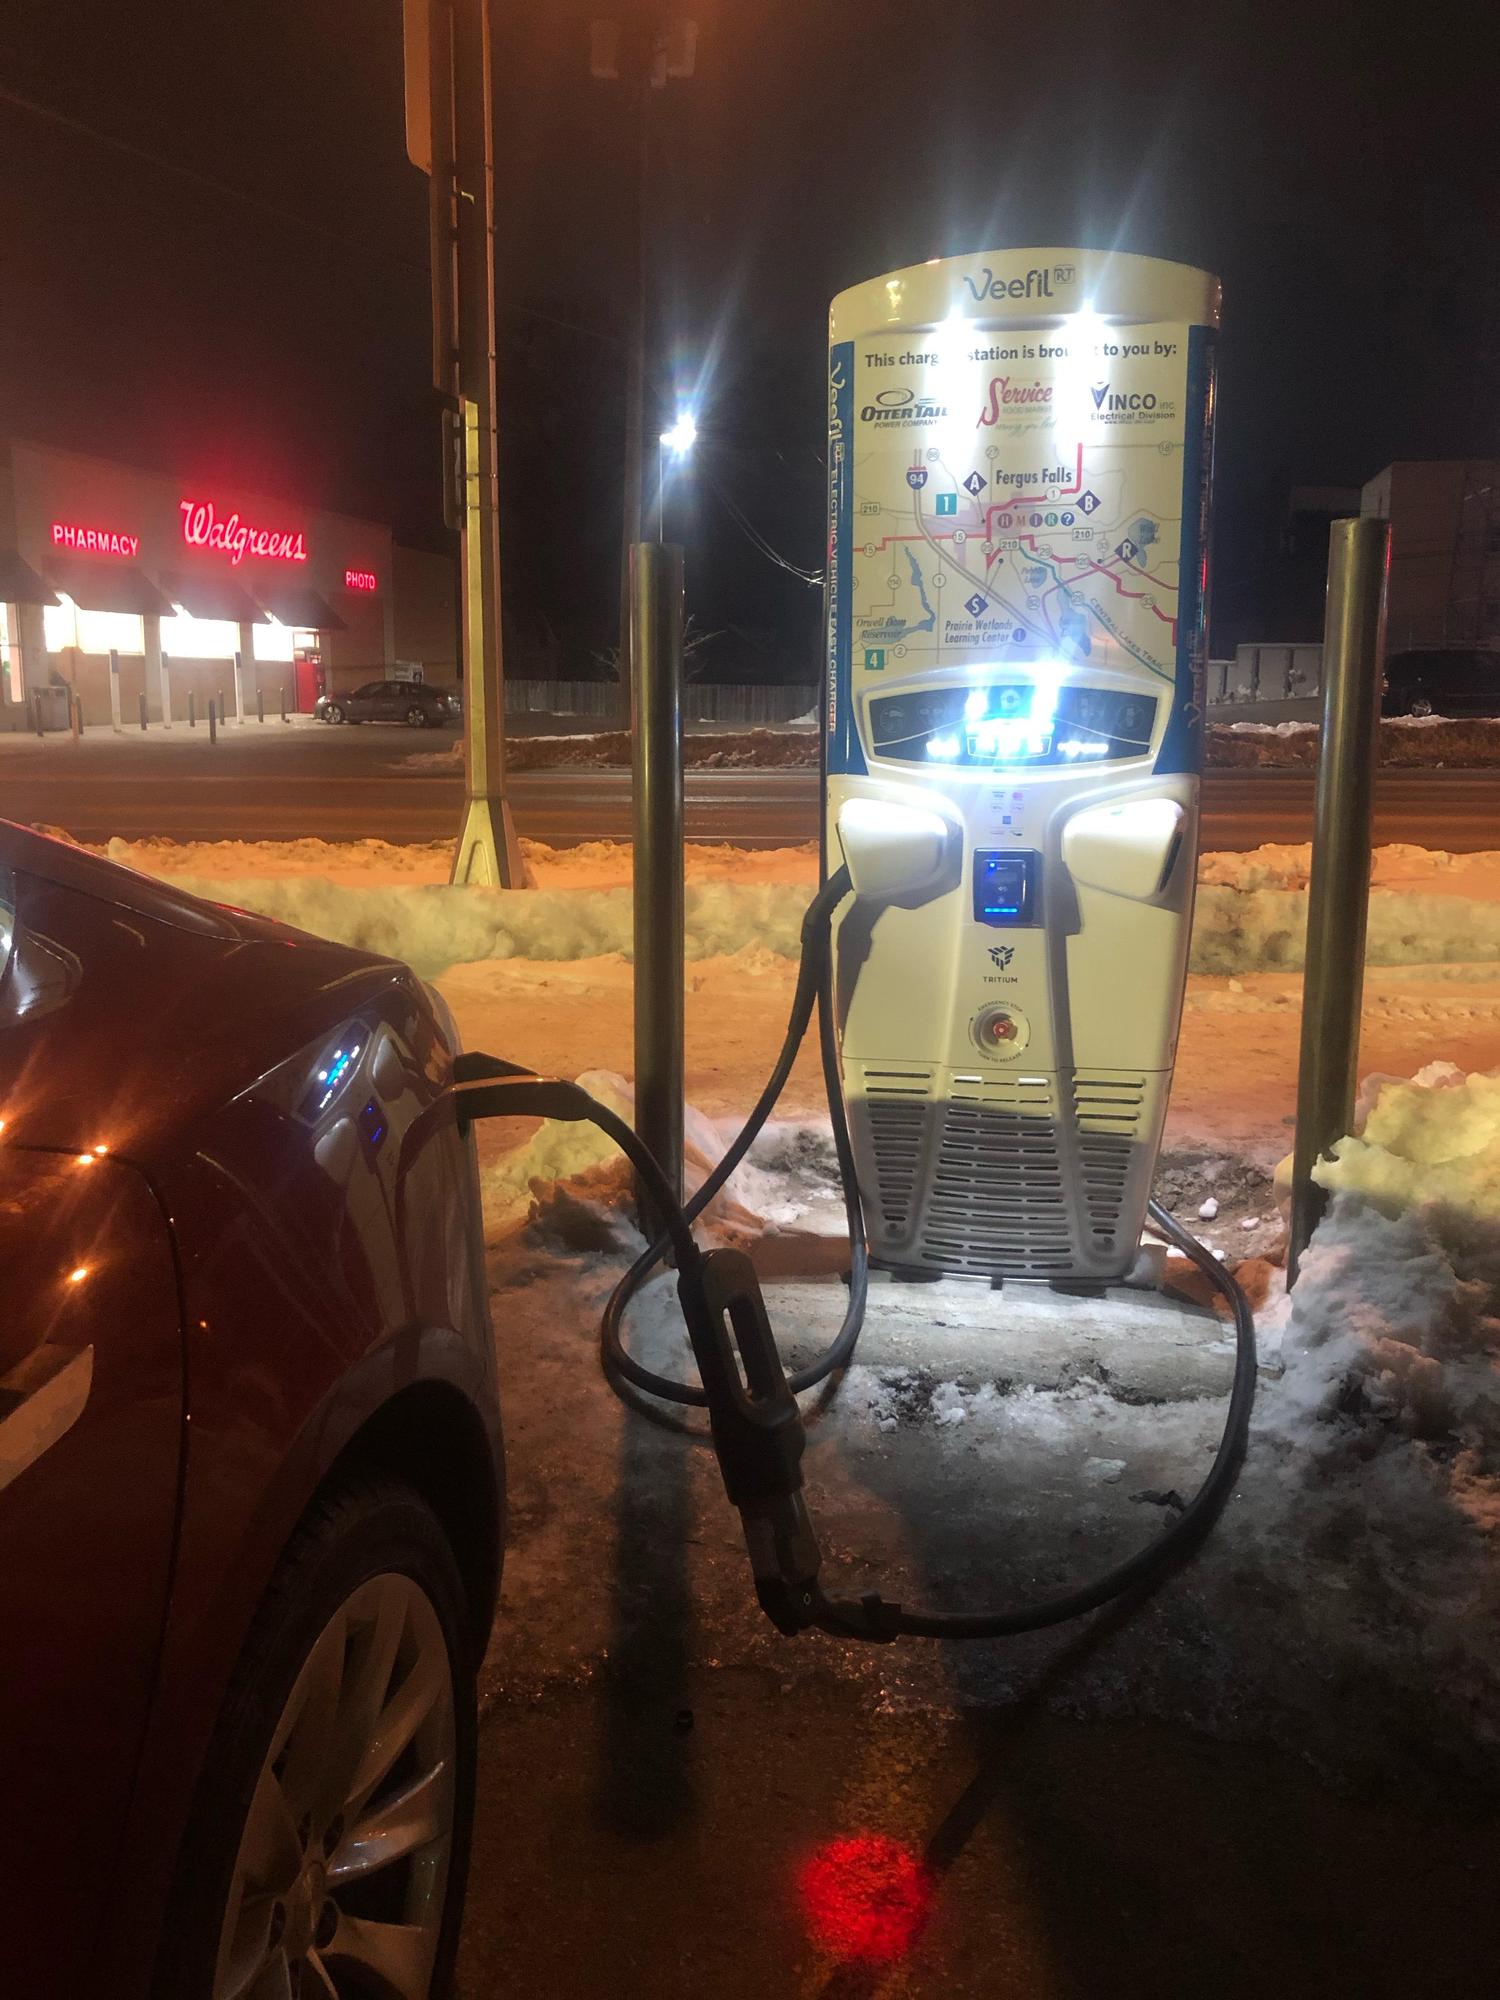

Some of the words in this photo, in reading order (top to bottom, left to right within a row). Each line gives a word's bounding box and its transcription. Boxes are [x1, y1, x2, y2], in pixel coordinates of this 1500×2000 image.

[963, 267, 1054, 302] Veefil
[1055, 267, 1076, 282] RT
[865, 353, 895, 368] This
[899, 351, 944, 367] charg
[1022, 345, 1035, 359] is
[1103, 343, 1119, 356] to
[1122, 344, 1149, 359] you
[1154, 341, 1177, 359] by:
[976, 376, 1053, 429] Service
[1090, 382, 1157, 411] VINCO
[861, 406, 914, 421] OTTER
[1090, 412, 1135, 421] Electrical
[1138, 411, 1176, 420] Division
[874, 420, 901, 429] POWER
[909, 474, 924, 485] 94
[969, 474, 980, 490] A
[996, 469, 1038, 488] Fergus
[1042, 467, 1072, 483] Falls
[830, 468, 838, 545] ELECTRIC
[862, 504, 878, 513] 210
[1084, 495, 1093, 512] B
[52, 524, 140, 557] PHARMACY
[180, 500, 308, 565] Walgreens
[1074, 530, 1091, 538] 210
[1001, 540, 1018, 549] 210
[1122, 542, 1132, 558] R
[345, 569, 377, 592] PHOTO
[830, 549, 838, 613] VEHICLE
[971, 598, 980, 614] S
[856, 616, 884, 627] Orwell
[945, 620, 973, 631] Prairie
[975, 618, 1013, 630] Wetlands
[829, 618, 837, 656] FAST
[945, 632, 980, 645] Learning
[982, 631, 1009, 642] Center
[828, 660, 837, 733] CHARGER
[983, 976, 1018, 984] TRITIUM
